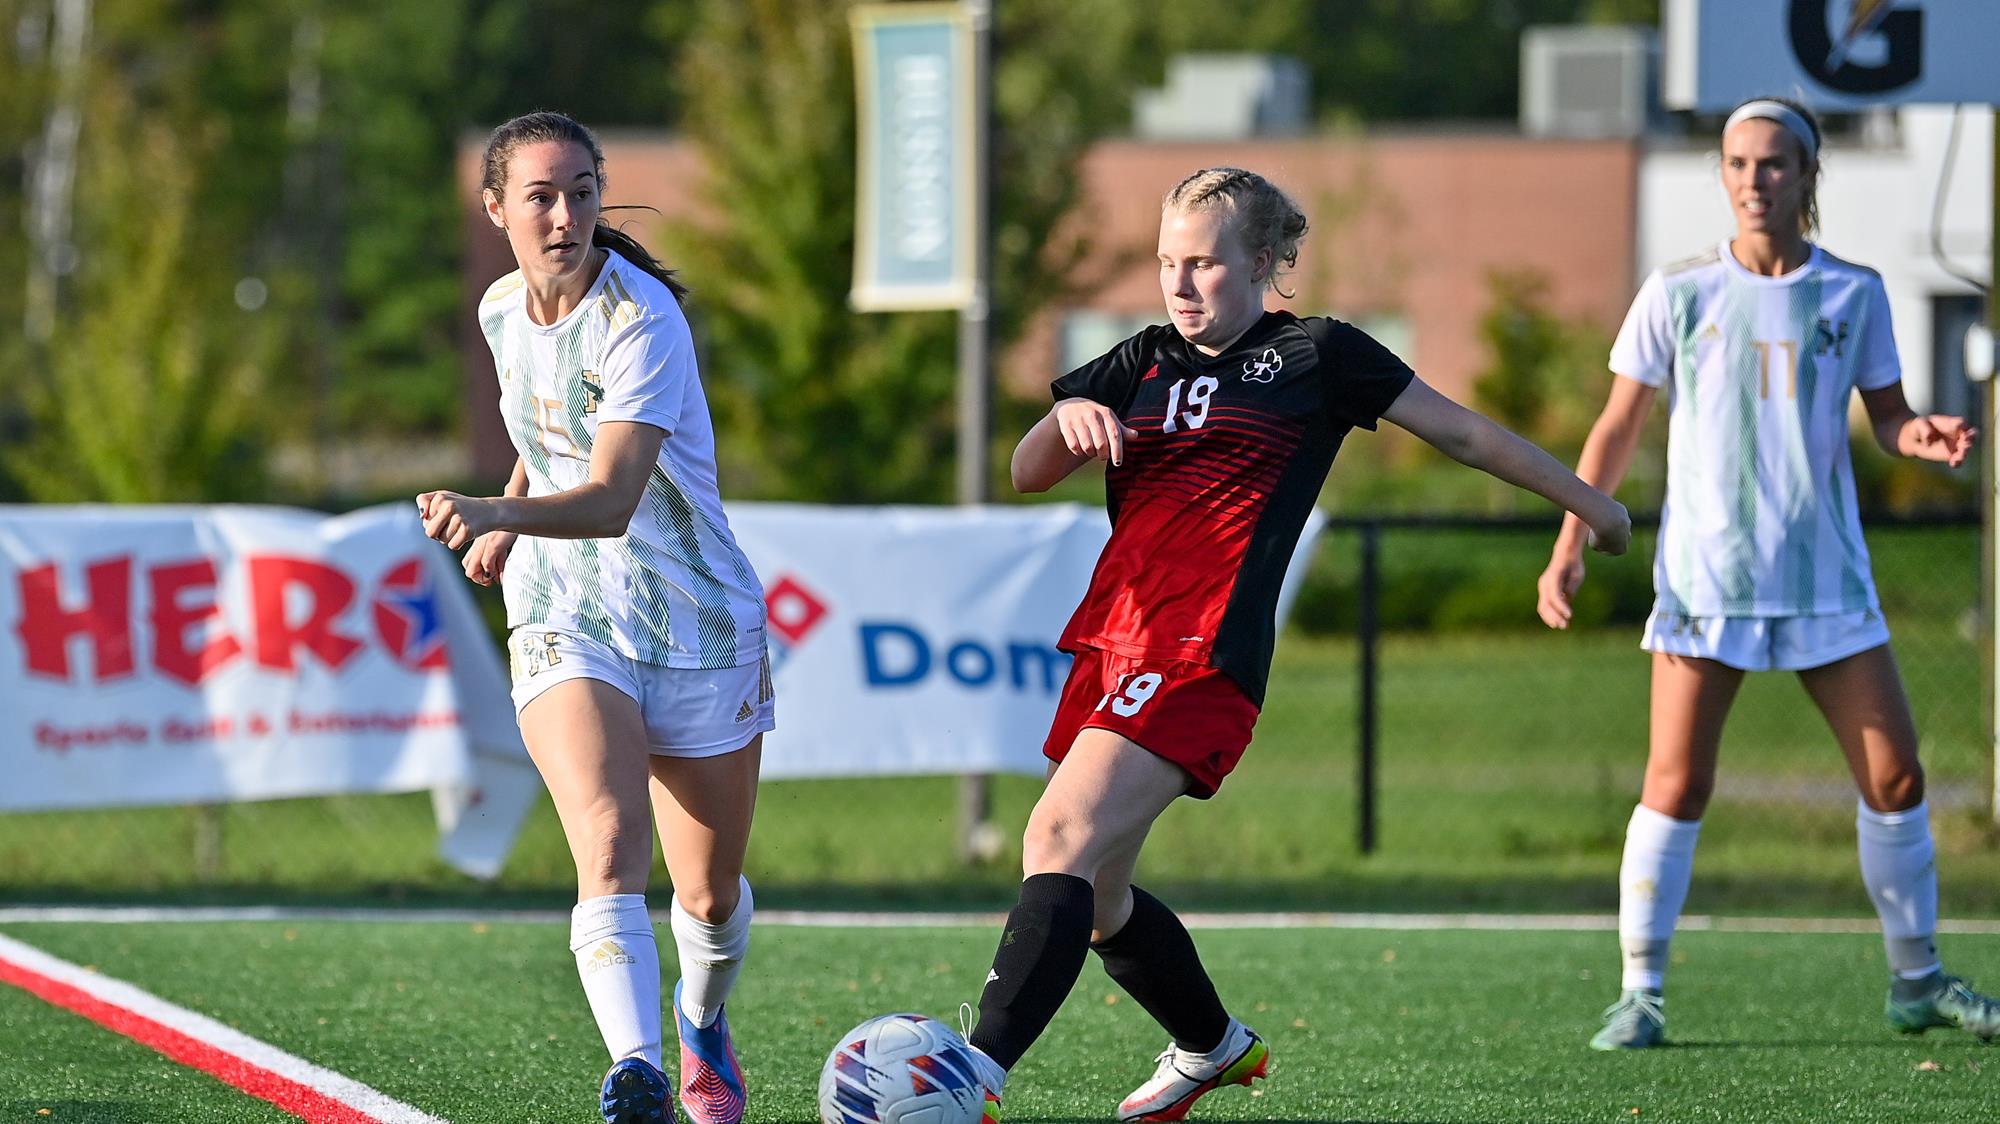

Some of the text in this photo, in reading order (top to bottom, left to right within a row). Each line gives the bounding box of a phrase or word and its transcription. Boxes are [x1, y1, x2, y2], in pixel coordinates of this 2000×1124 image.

[1751, 340, 1798, 400] 11
[529, 395, 579, 458] 15
[1163, 375, 1218, 433] 19
[1094, 672, 1162, 717] 19
